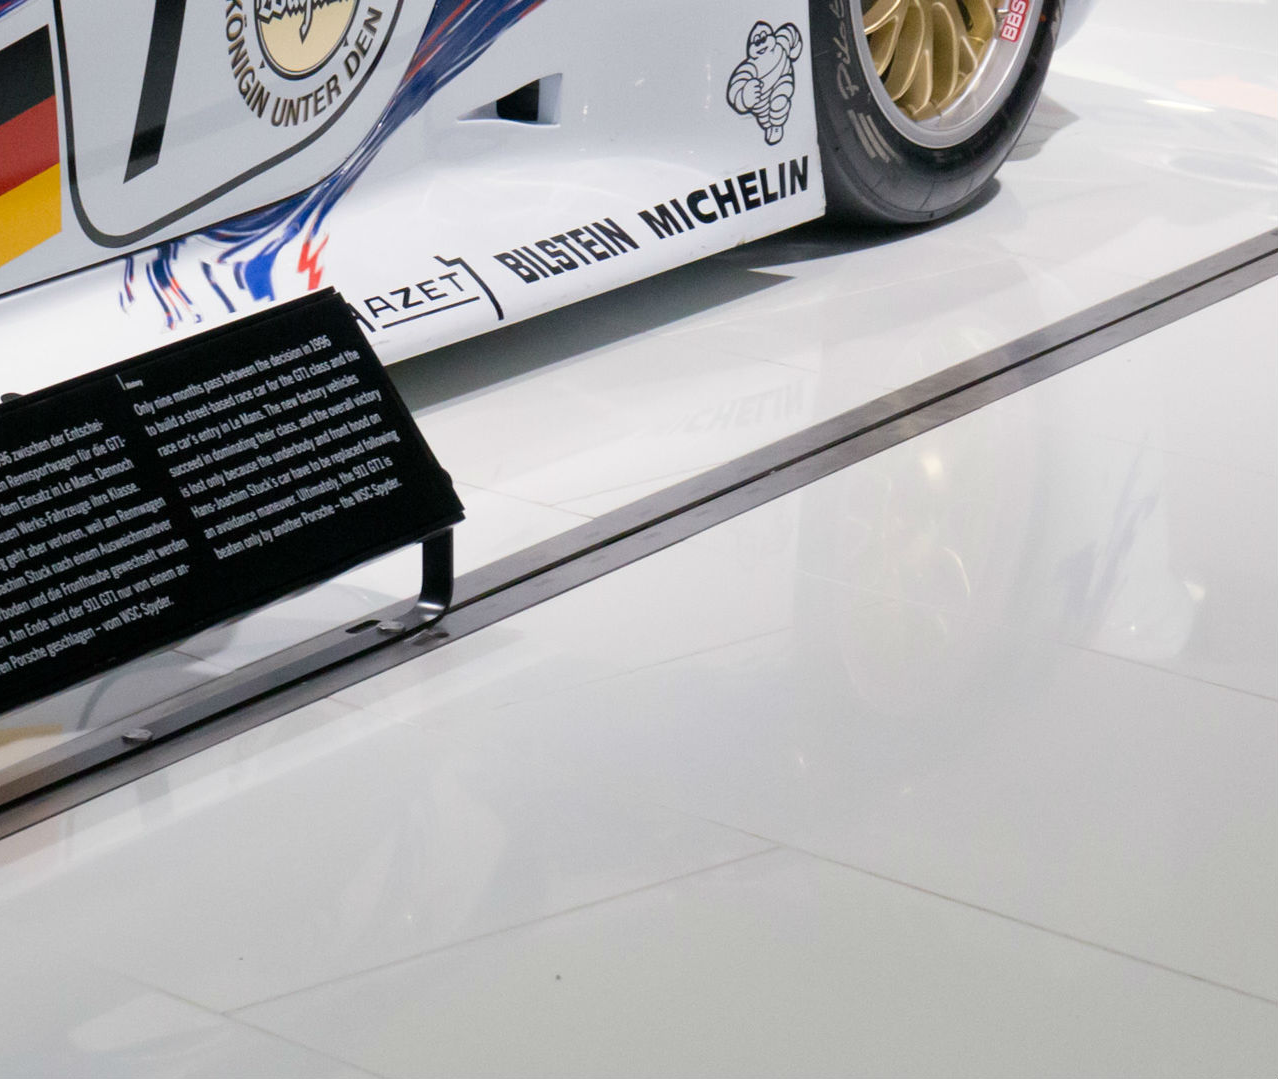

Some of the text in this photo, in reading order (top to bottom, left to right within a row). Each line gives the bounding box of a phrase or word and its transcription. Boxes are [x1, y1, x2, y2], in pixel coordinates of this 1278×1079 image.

[270, 77, 341, 128] UNTER
[344, 6, 384, 80] DEN
[494, 218, 639, 284] BILSTEIN
[638, 155, 808, 239] MICHELIN
[133, 334, 332, 416] Only nine months pass between the decision in 1996
[144, 350, 361, 437] to build a street-based race car for the GT1 class and the
[5, 454, 79, 488] Rennsportwagen
[76, 448, 92, 462] für
[91, 443, 108, 457] die
[105, 435, 126, 452] GT1-
[11, 439, 52, 462] zwischen
[49, 433, 66, 448] der
[63, 418, 104, 442] Entschei-
[0, 501, 21, 517] dem
[17, 489, 53, 509] Einsatz
[49, 485, 62, 497] in
[57, 481, 73, 494] Le
[69, 473, 99, 489] Mans.
[94, 457, 135, 480] Dennoch
[16, 500, 92, 534] Werks-Fahrzeuge
[89, 493, 110, 508] ihre
[106, 482, 141, 501] Klasse.
[203, 455, 394, 540] an avoidance maneuver. Ultimately, the 911 GT1 is
[5, 548, 29, 569] geht
[26, 542, 48, 558] aber
[46, 528, 88, 549] verloren,
[84, 518, 105, 535] weil
[103, 515, 120, 528] am
[116, 497, 166, 522] Rennwagen
[24, 564, 53, 584] Stuck
[51, 556, 75, 574] nach
[72, 547, 101, 566] einem
[98, 519, 172, 555] Ausweichmanöver
[9, 628, 28, 643] Am
[24, 618, 50, 637] Ende
[48, 608, 71, 627] wird
[68, 605, 85, 619] der
[82, 596, 102, 613] 911
[98, 589, 119, 607] GT1
[116, 585, 133, 600] nur
[132, 579, 151, 593] von
[149, 568, 177, 587] einem
[175, 564, 190, 576] an-
[28, 591, 49, 609] und
[46, 587, 63, 602] die
[59, 569, 111, 596] Fronthaube
[110, 548, 159, 579] gewechselt
[156, 538, 189, 558] werden
[9, 647, 48, 669] Porsche
[46, 627, 96, 657] geschlagen
[101, 616, 123, 631] vom
[118, 605, 143, 624] WSC
[139, 596, 174, 616] Spyder.
